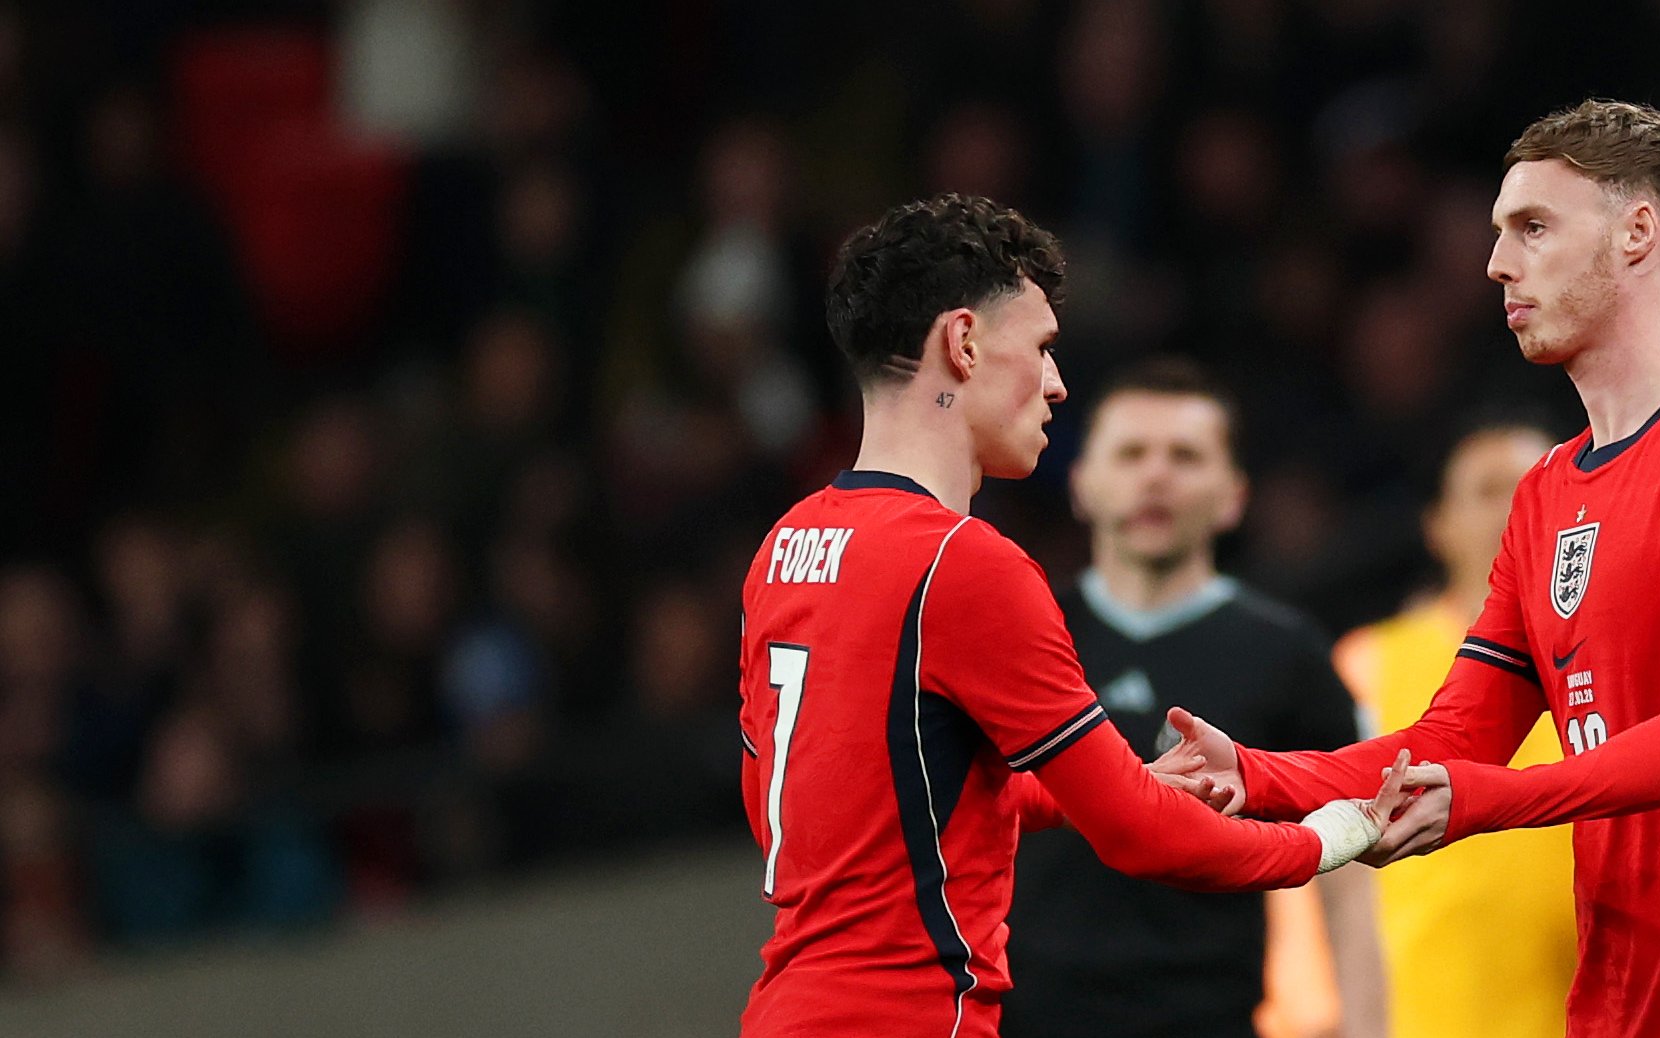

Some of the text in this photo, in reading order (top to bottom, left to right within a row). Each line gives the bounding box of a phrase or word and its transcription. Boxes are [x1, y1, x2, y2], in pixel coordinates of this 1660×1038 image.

[936, 392, 954, 408] 47
[766, 527, 855, 584] FODEN
[763, 641, 810, 898] 7
